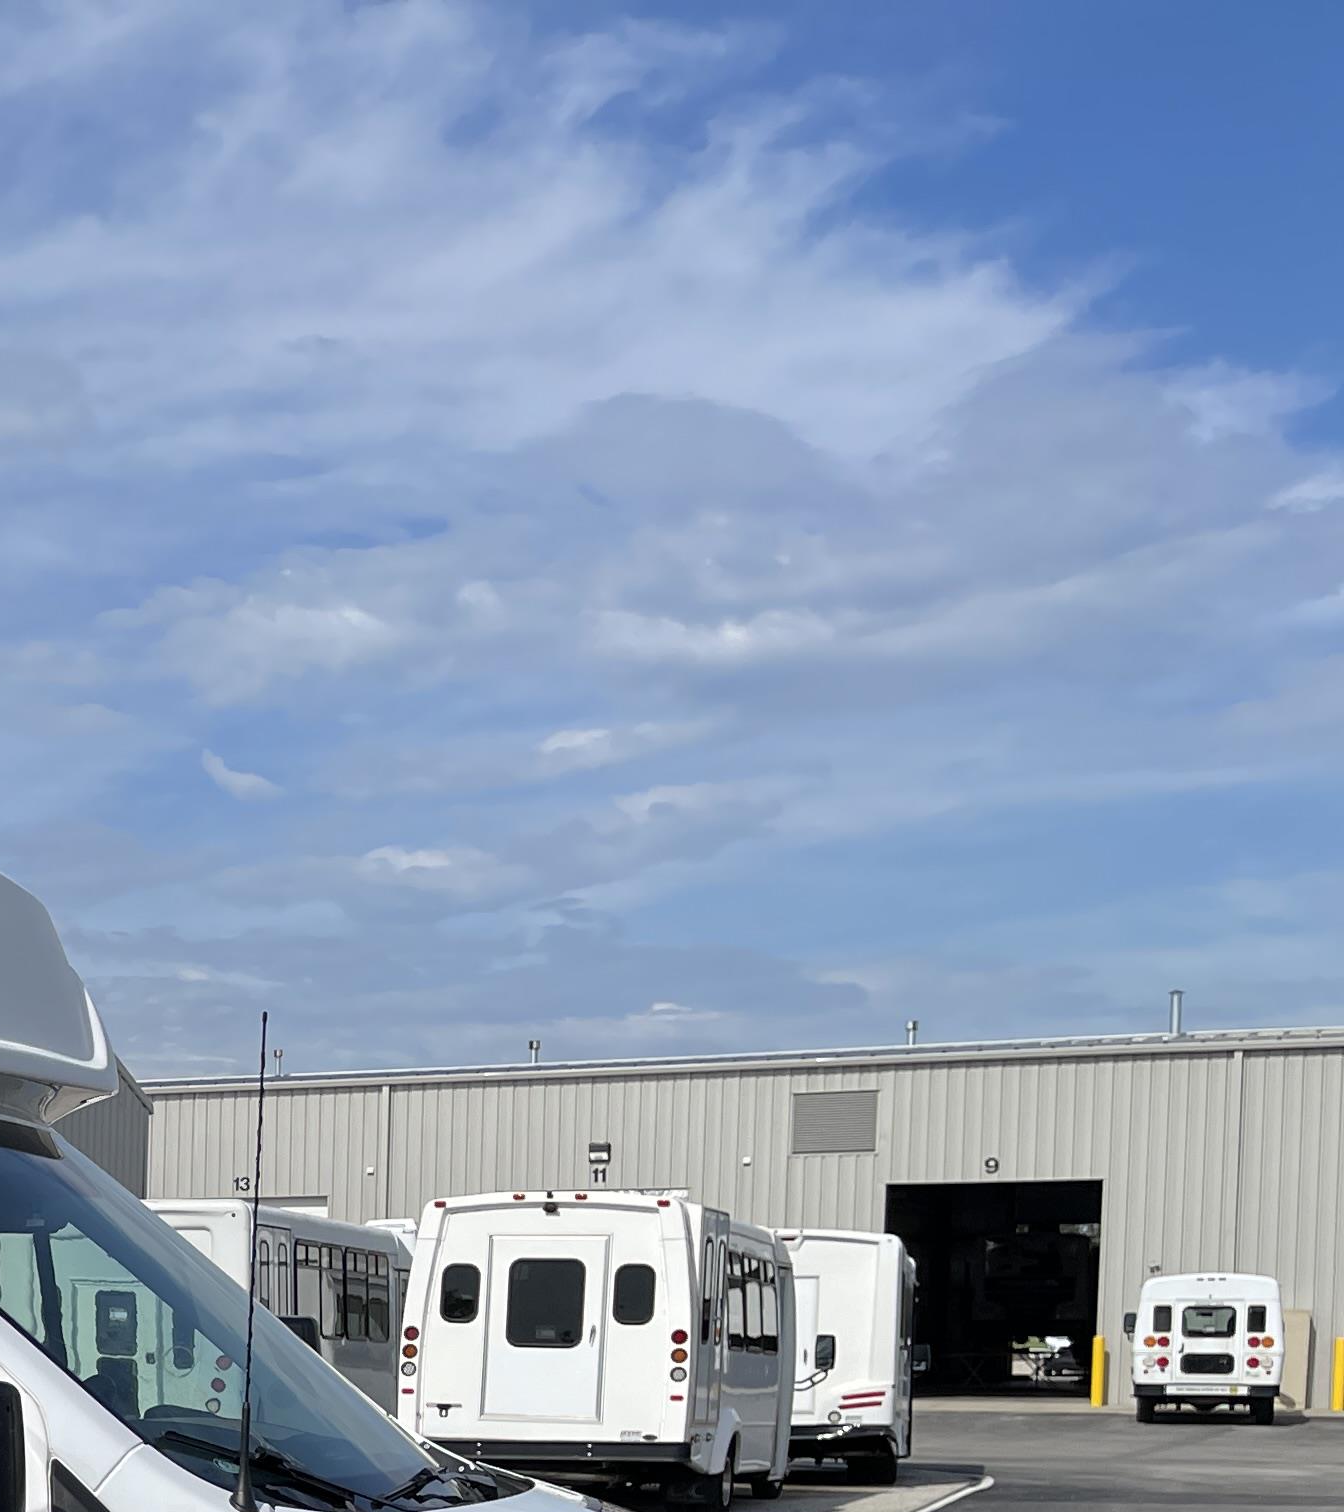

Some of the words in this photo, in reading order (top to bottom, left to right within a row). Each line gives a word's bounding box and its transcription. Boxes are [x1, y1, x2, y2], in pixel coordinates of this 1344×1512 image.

[985, 1157, 999, 1174] 9
[592, 1168, 606, 1183] 11
[233, 1177, 250, 1191] 13
